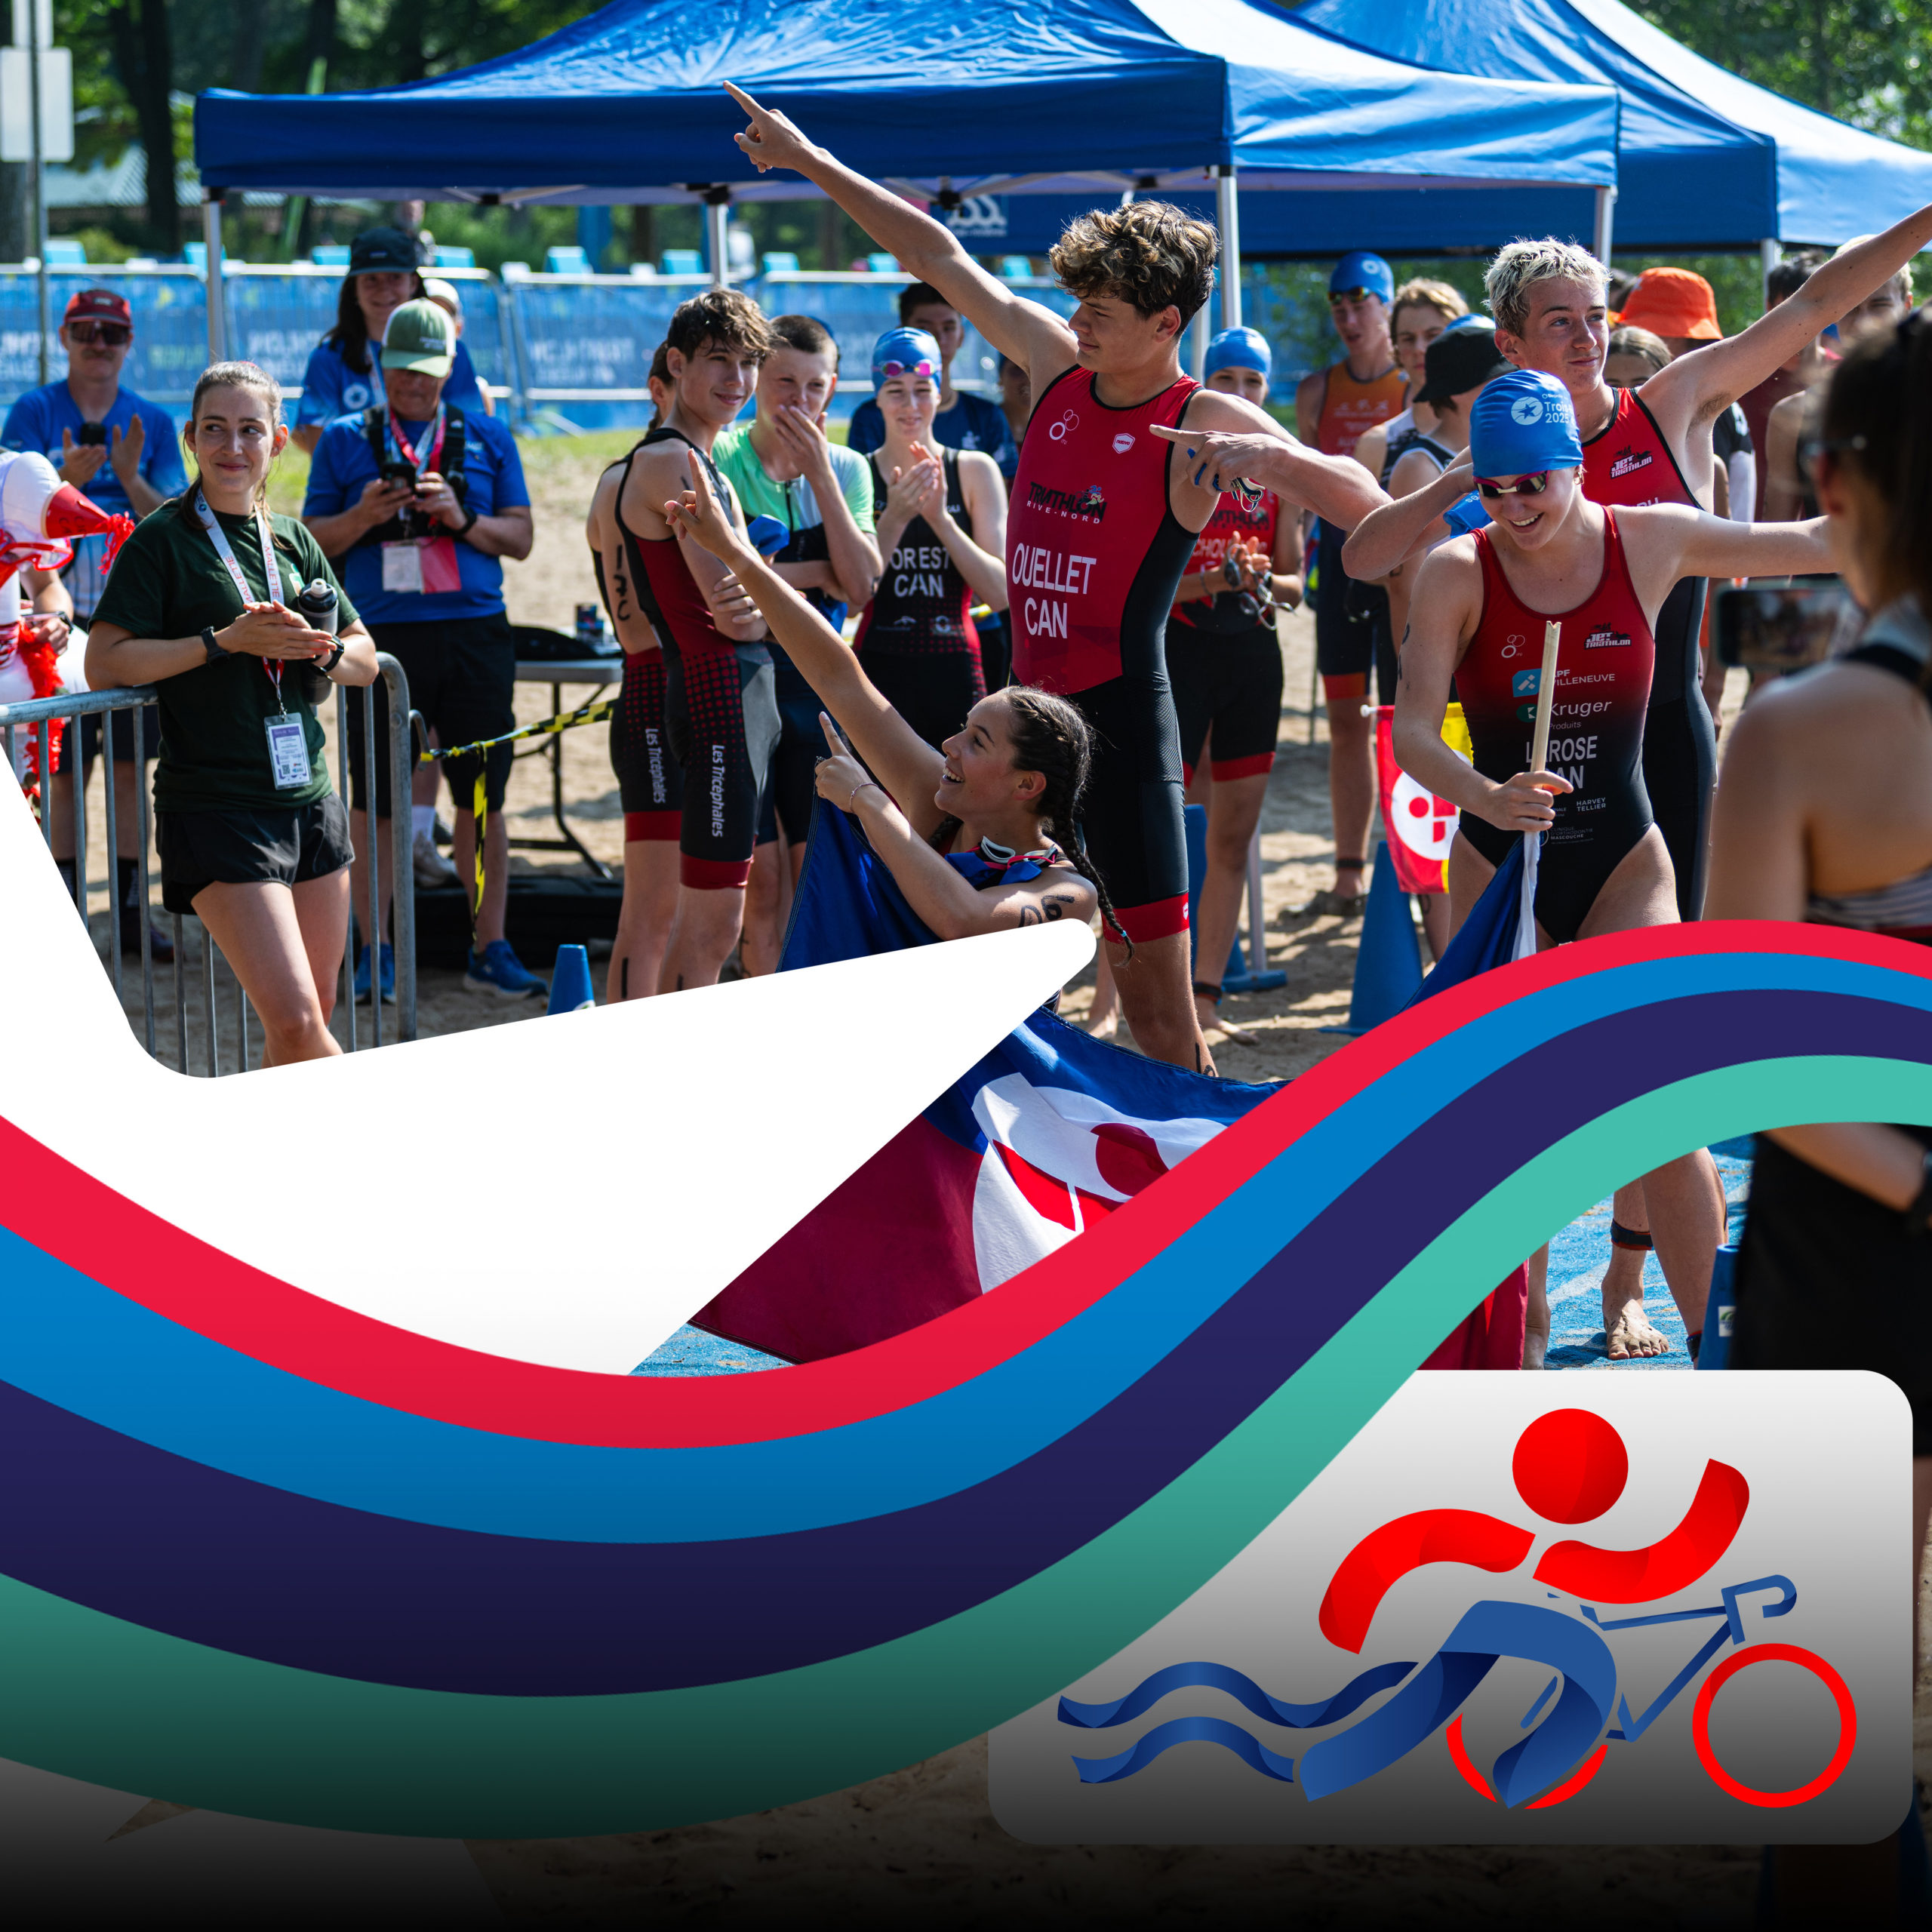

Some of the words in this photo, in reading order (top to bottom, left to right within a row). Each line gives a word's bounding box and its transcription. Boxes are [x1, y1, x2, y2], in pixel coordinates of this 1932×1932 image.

[1545, 413, 1570, 423] 2025
[1029, 481, 1107, 522] TRIATHLON
[891, 546, 951, 571] OREST
[1012, 543, 1097, 595] OUELLET
[894, 574, 944, 598] CAN
[1025, 597, 1067, 639] CAN
[1555, 669, 1571, 678] PF
[1551, 701, 1613, 717] Kruger
[645, 728, 660, 746] Les
[712, 744, 725, 764] Les
[1526, 735, 1598, 764] LROSE
[709, 766, 726, 838] Tricéphales
[1577, 797, 1606, 806] HARVEY
[1577, 803, 1607, 812] TELLIER
